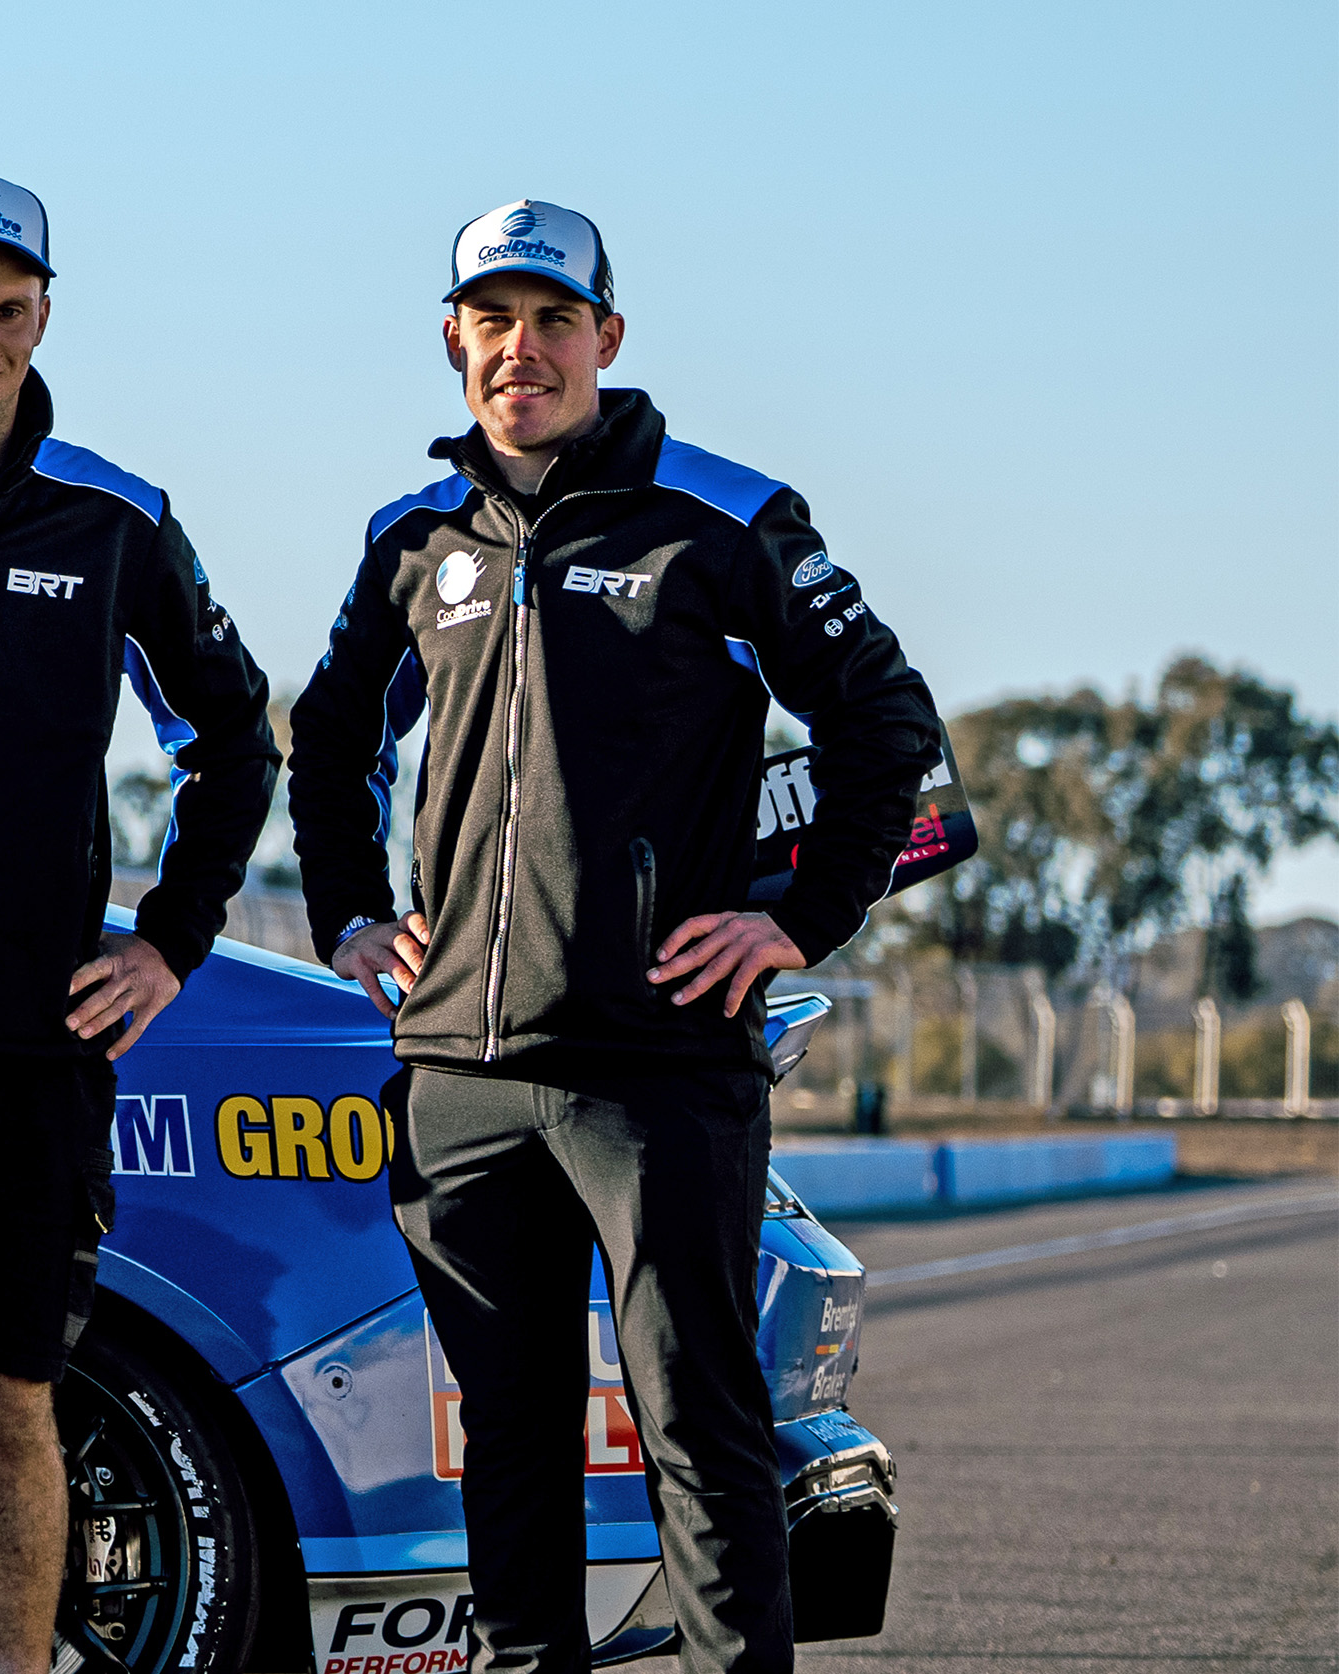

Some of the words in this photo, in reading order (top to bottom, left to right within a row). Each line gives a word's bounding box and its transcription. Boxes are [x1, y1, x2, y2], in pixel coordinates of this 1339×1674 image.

[478, 239, 566, 261] CoolDrive
[7, 567, 84, 599] BRT
[562, 565, 652, 598] BRT
[215, 1094, 394, 1182] GRO
